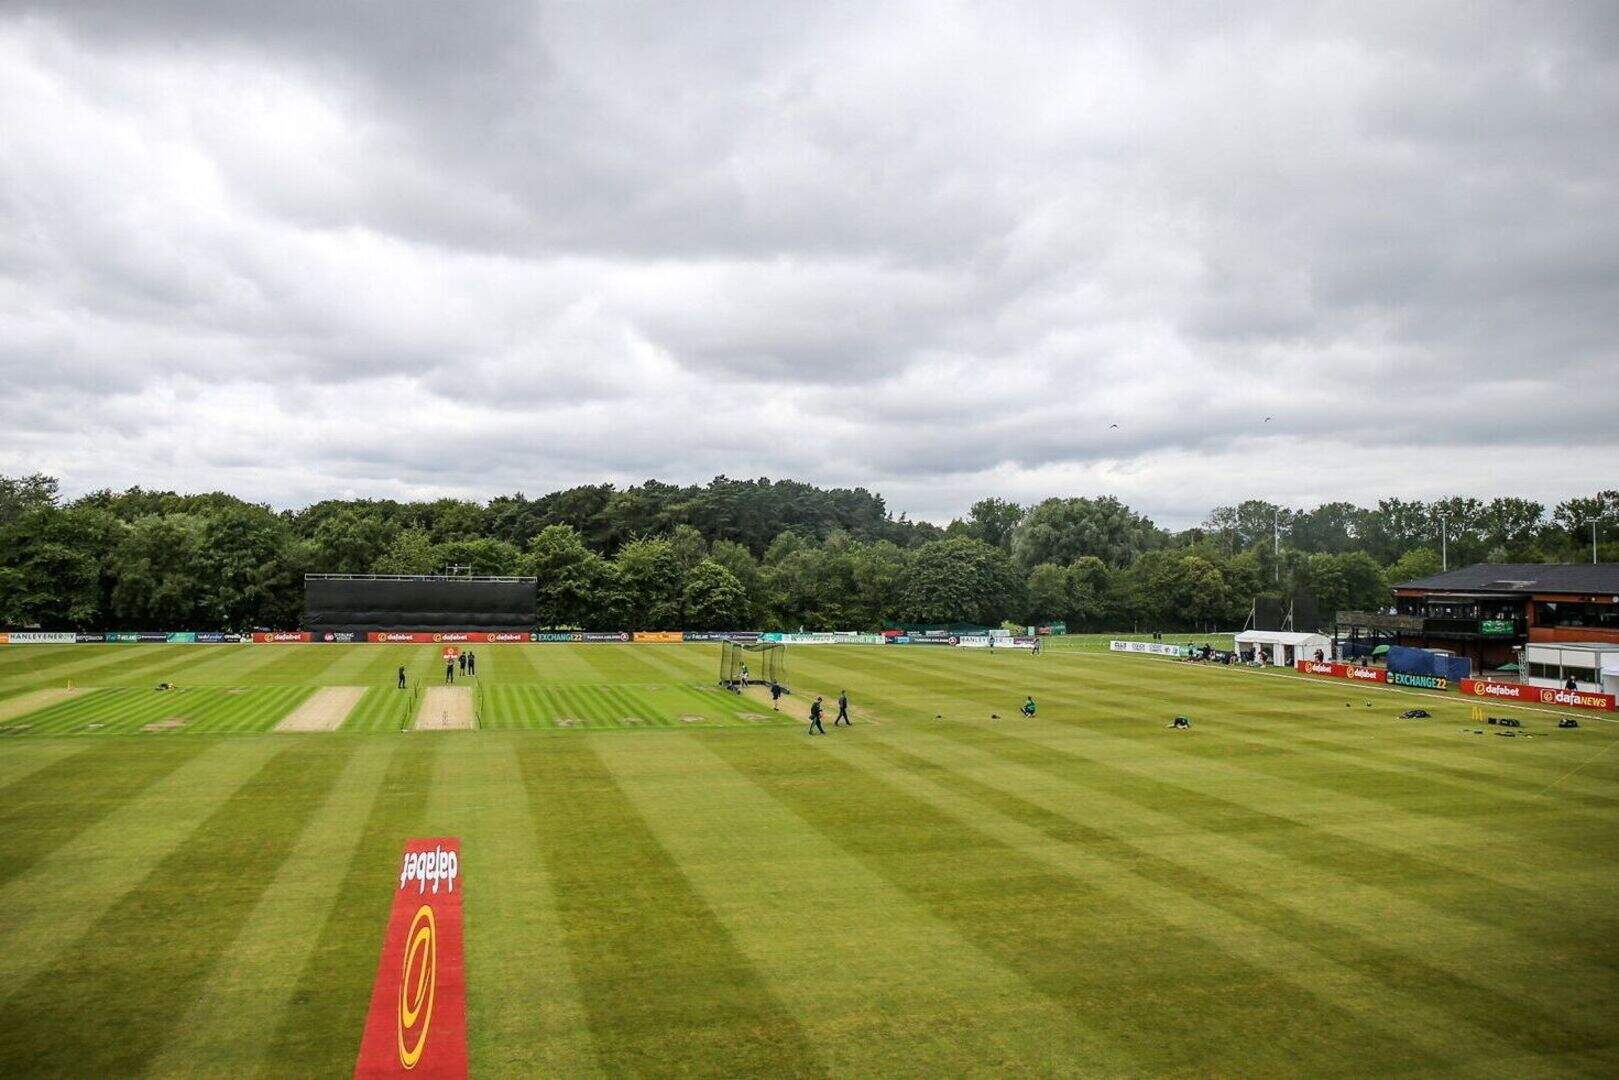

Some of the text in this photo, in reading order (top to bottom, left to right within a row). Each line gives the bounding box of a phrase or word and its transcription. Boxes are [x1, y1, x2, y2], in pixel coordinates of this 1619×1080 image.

[387, 633, 413, 641] dafabet
[442, 633, 468, 641] dafabet
[496, 633, 521, 641] dafabet
[538, 633, 583, 641] EXCHANGE22
[1312, 662, 1332, 674] dafabet
[1354, 668, 1376, 679] dafabet
[1395, 673, 1447, 690] EXCHANGE22
[1486, 683, 1520, 697] dafabet
[401, 845, 457, 894] dafabet
